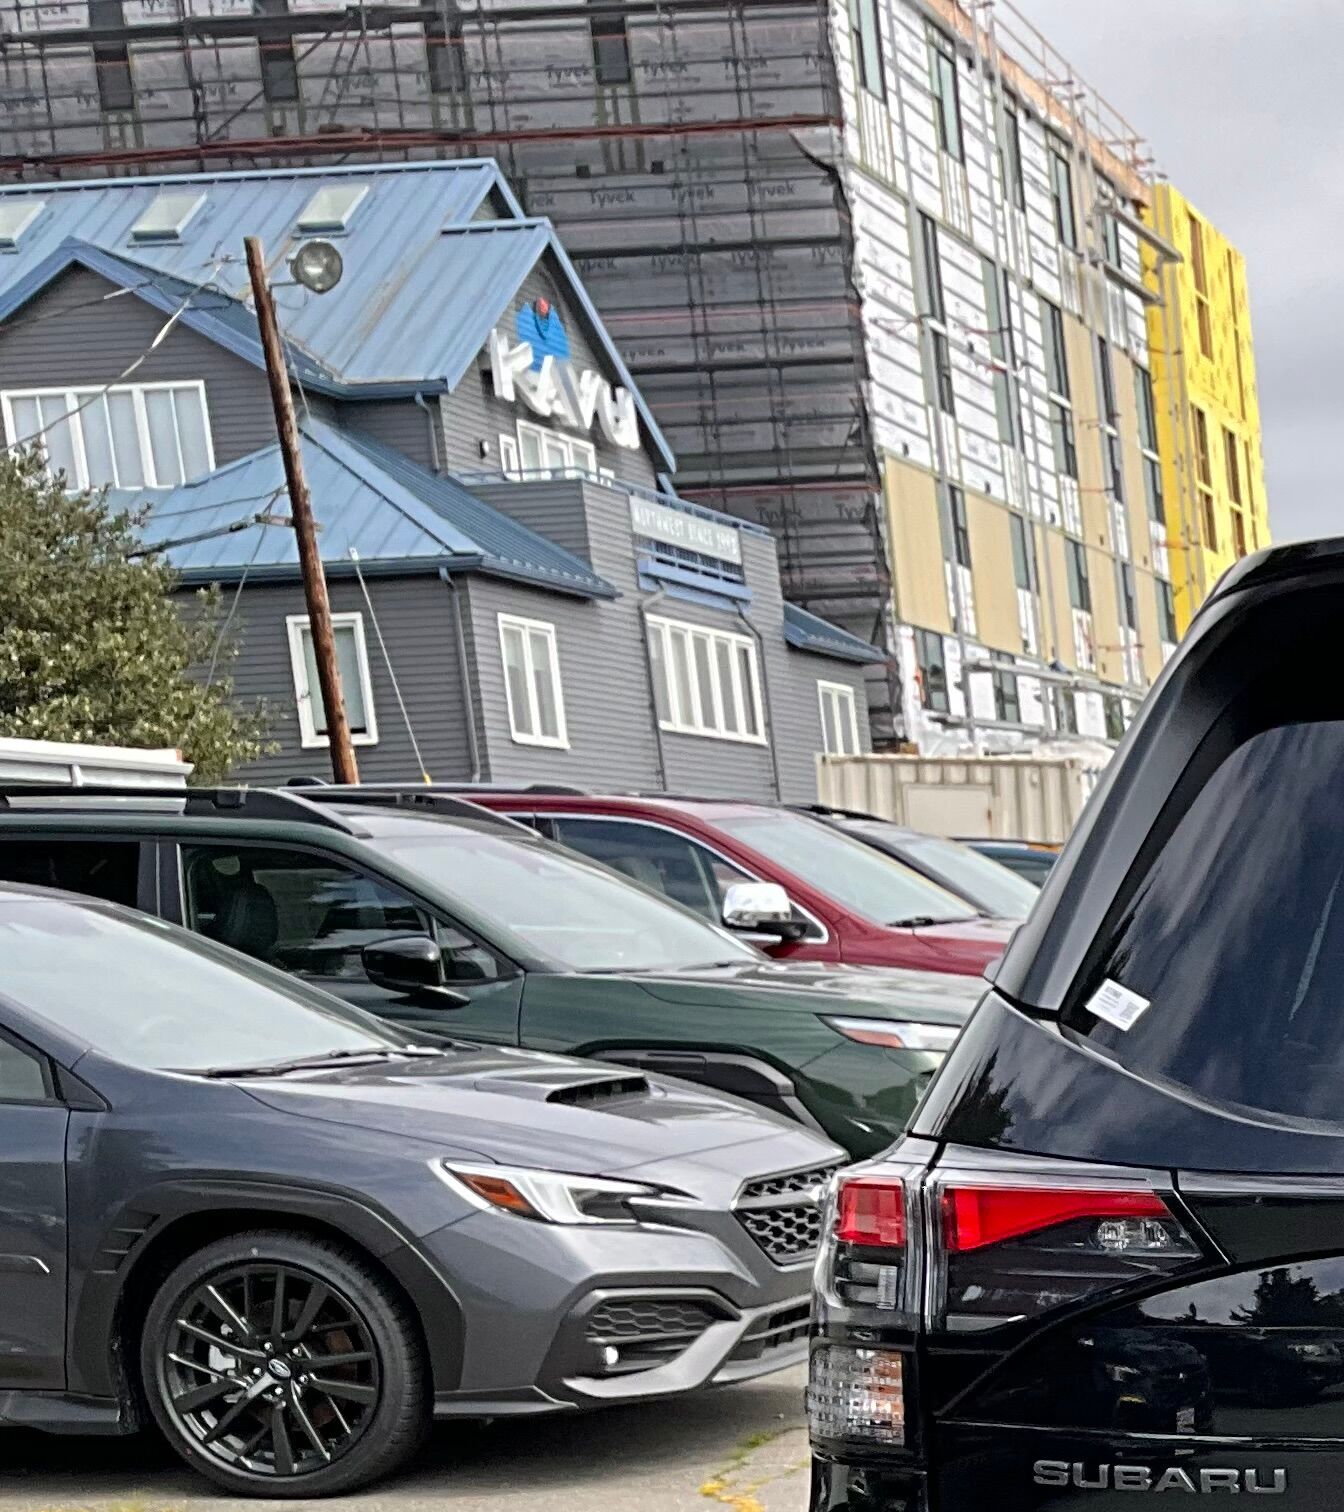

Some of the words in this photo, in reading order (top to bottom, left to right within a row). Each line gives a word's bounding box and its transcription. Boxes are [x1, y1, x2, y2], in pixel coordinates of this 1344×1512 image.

[590, 187, 635, 208] Tyvek
[490, 328, 640, 449] KAVU
[1032, 1458, 1288, 1495] SUBARU
